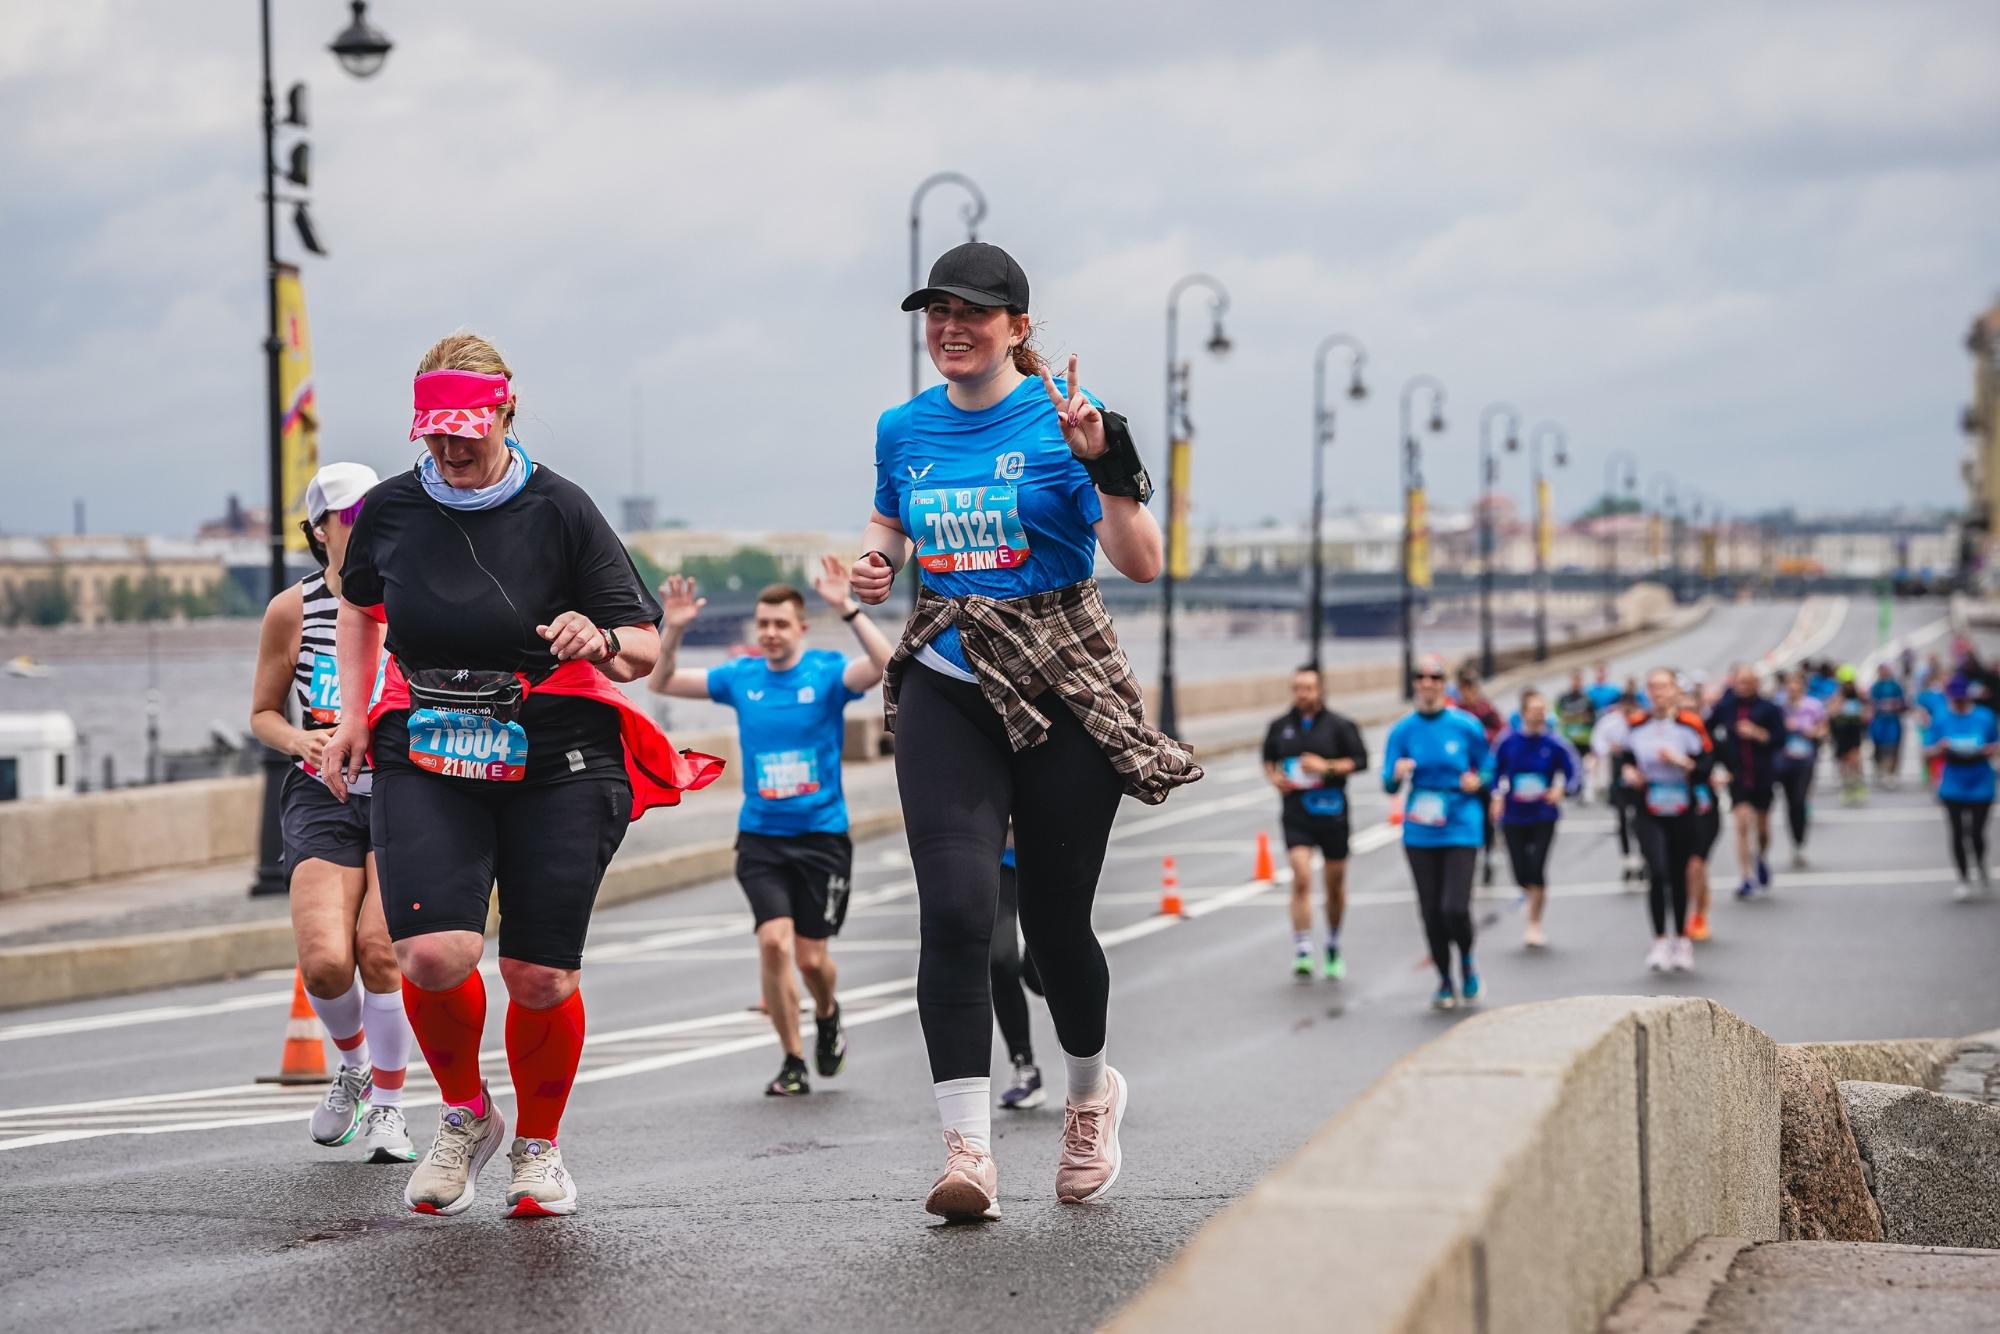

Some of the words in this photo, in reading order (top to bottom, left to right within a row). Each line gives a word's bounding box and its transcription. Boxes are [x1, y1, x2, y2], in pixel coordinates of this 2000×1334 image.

[994, 452, 1025, 480] 10
[955, 491, 972, 509] 10
[925, 510, 1008, 550] 70127
[953, 550, 998, 572] 21.1KM
[1000, 550, 1010, 563] E
[458, 716, 478, 728] 10
[425, 727, 511, 762] 71604
[441, 756, 487, 780] 21.1KM
[491, 765, 503, 777] E
